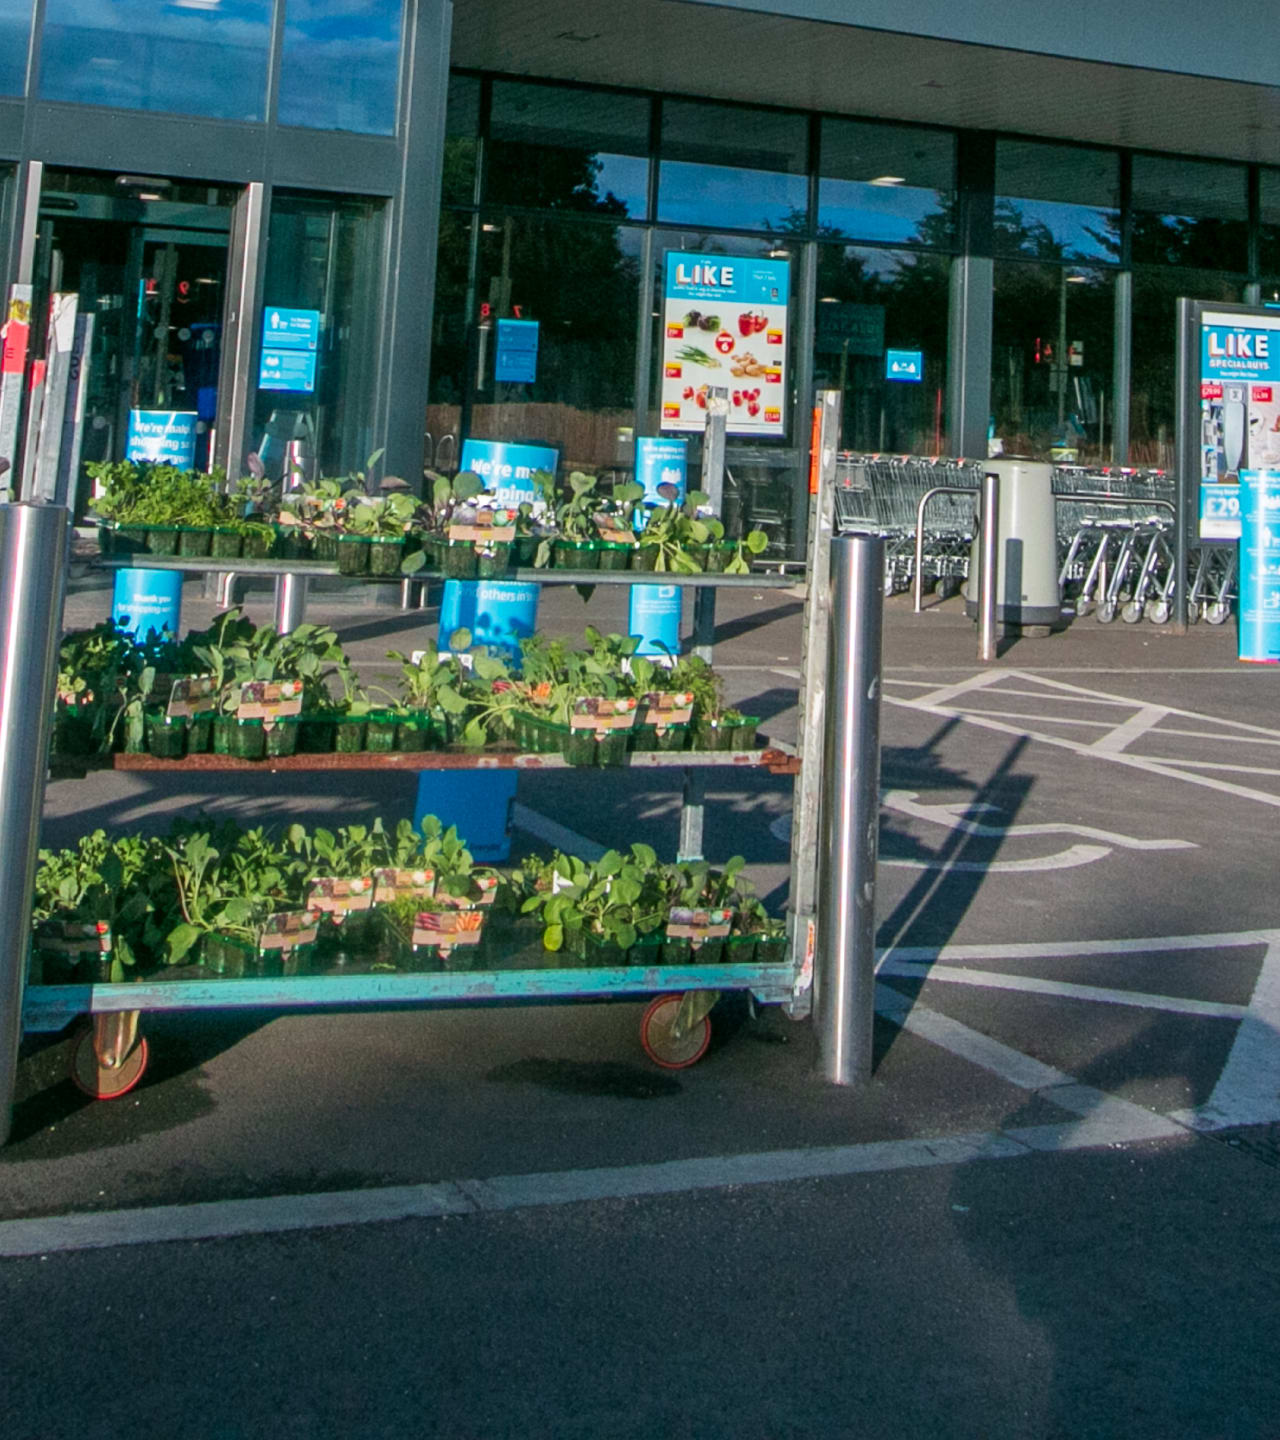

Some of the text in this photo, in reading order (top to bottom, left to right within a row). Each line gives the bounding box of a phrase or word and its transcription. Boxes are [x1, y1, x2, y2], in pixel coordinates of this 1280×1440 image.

[676, 263, 735, 288] LIKE
[720, 343, 729, 353] 6
[1208, 332, 1270, 359] LIKE
[471, 458, 513, 478] We're
[480, 588, 515, 602] others
